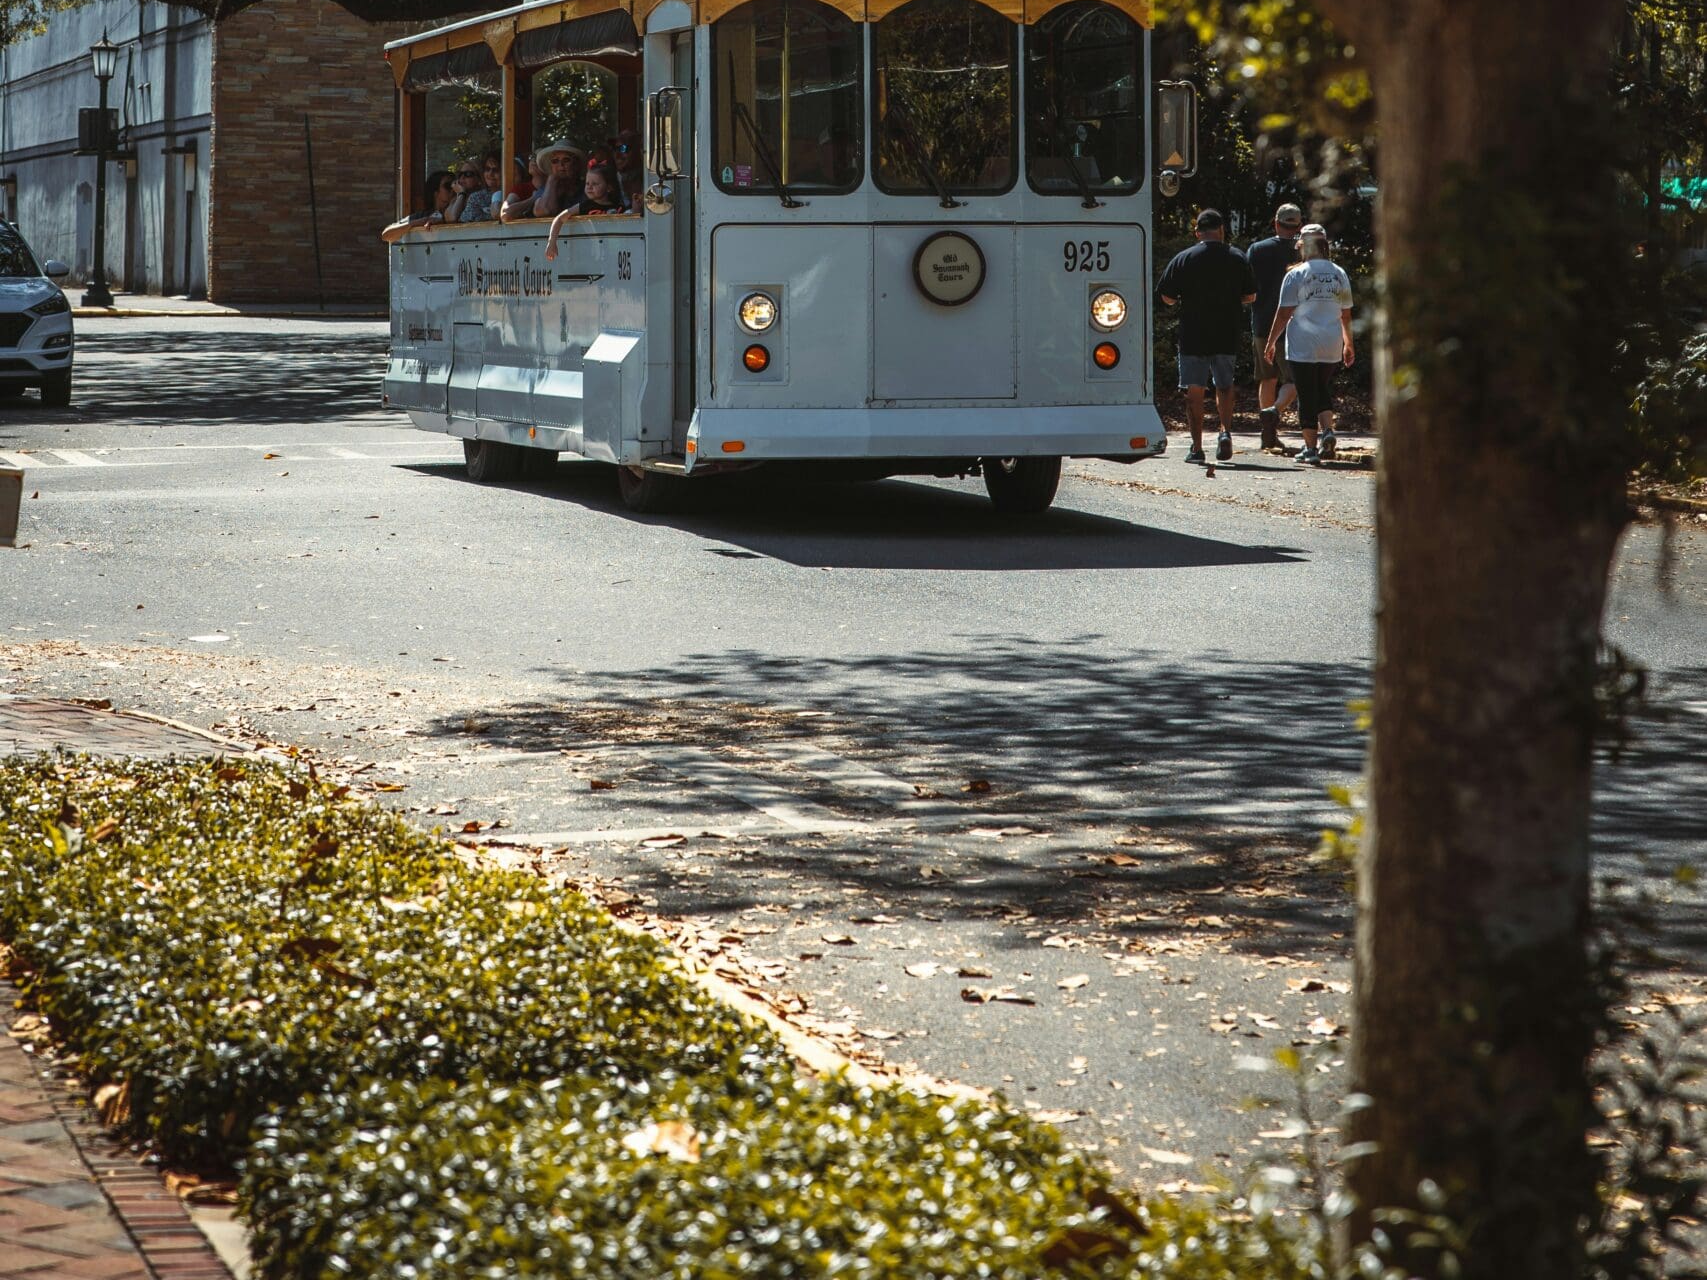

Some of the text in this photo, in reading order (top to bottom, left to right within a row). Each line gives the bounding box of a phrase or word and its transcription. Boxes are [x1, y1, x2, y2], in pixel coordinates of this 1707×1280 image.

[617, 250, 631, 280] 925
[942, 253, 958, 263] Old
[1064, 240, 1110, 272] 925
[458, 256, 552, 298] Old Savannah Tours
[932, 263, 970, 273] Savannah
[938, 273, 964, 282] Tours
